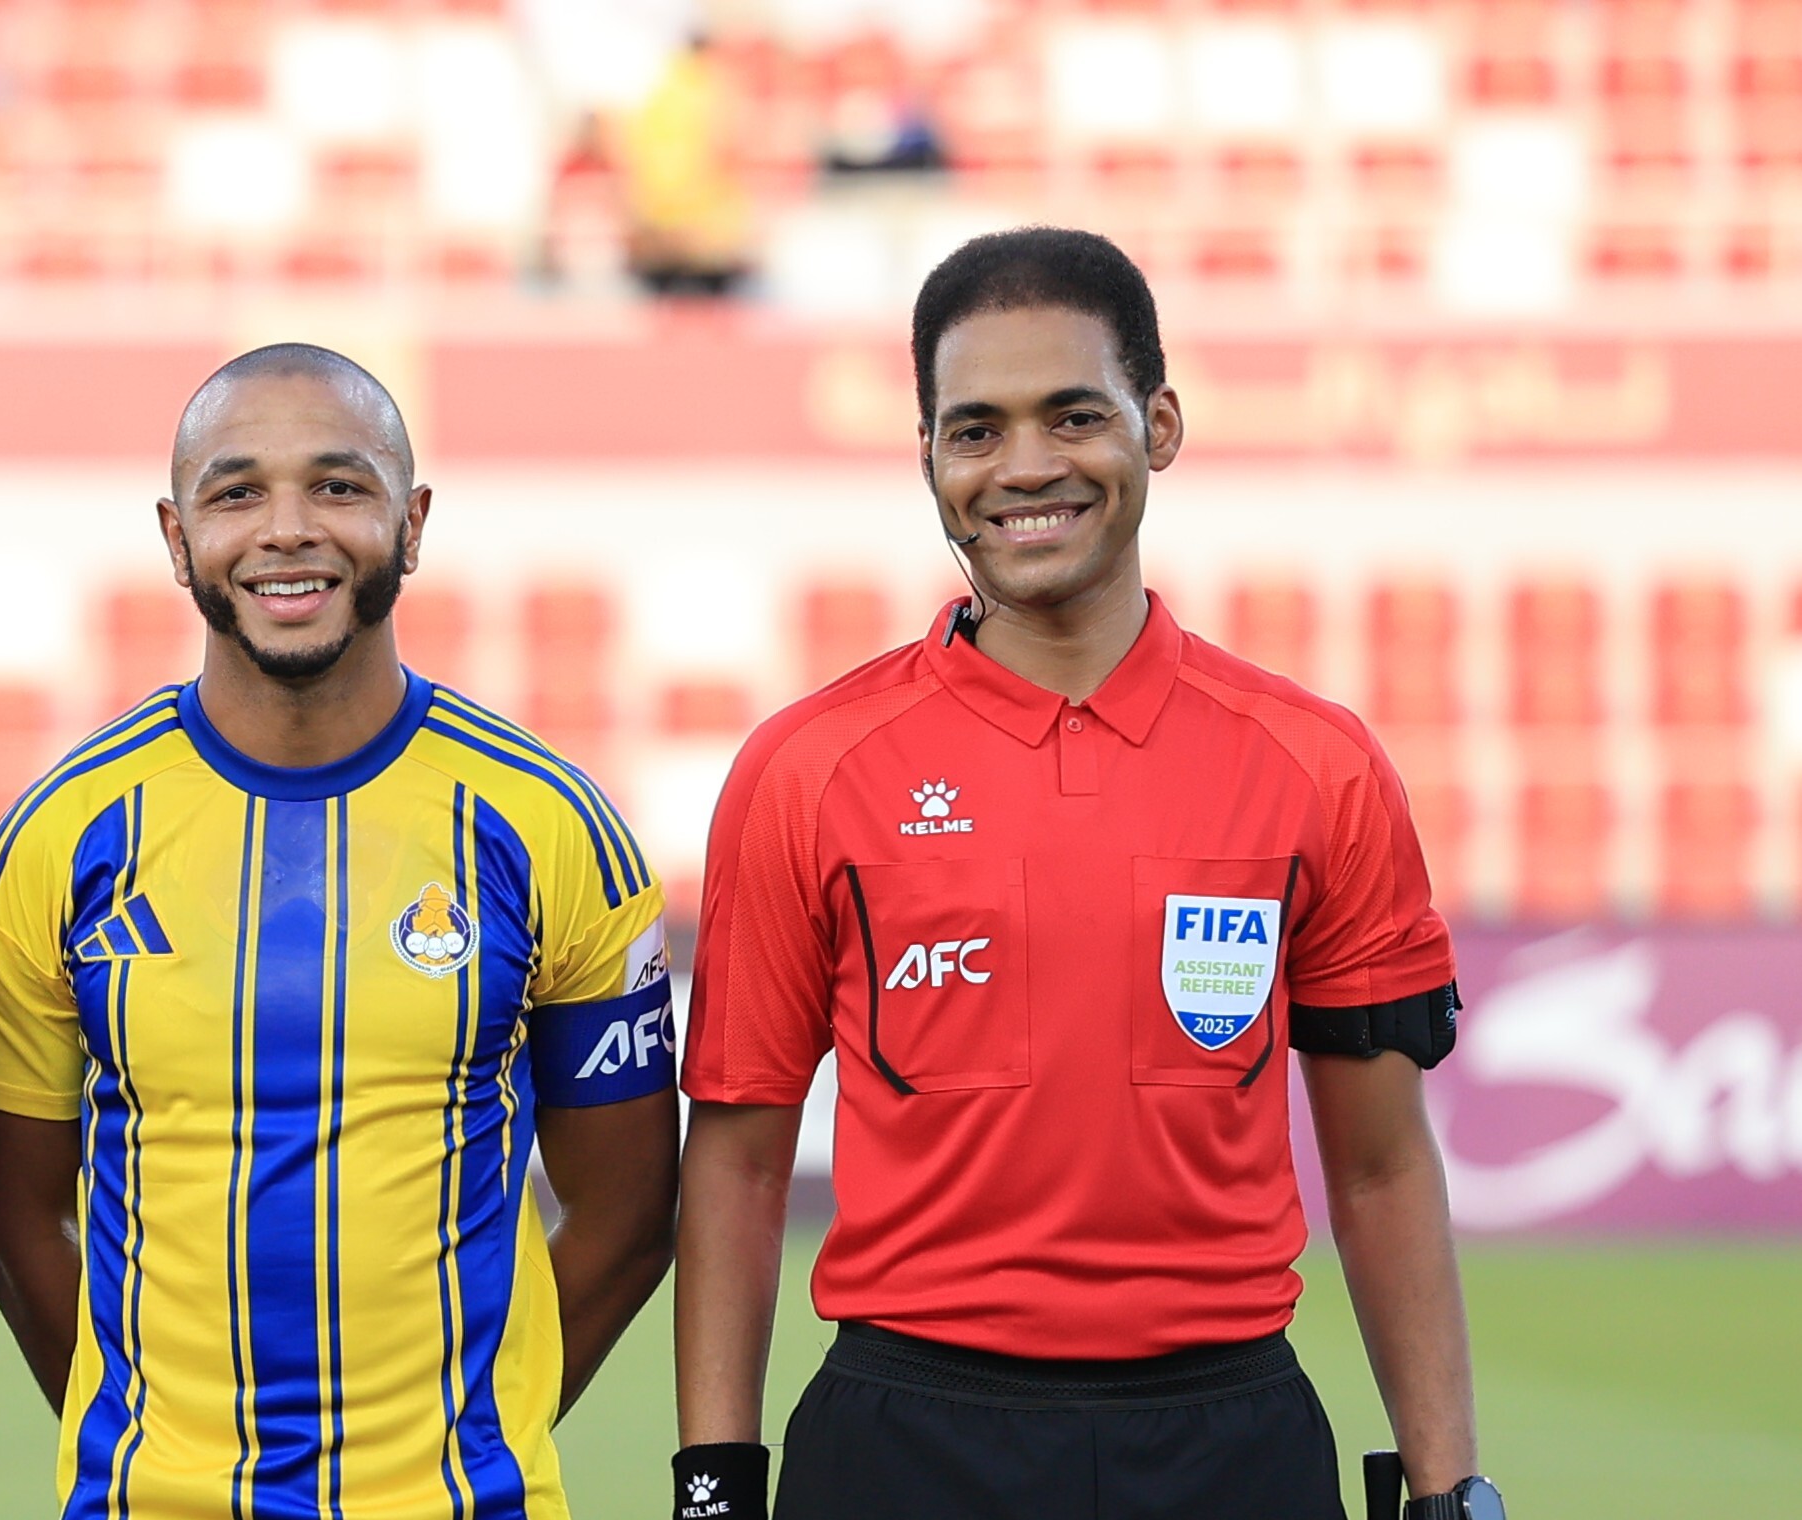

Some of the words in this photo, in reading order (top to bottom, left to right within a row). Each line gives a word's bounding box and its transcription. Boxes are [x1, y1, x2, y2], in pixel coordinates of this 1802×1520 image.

[900, 819, 973, 835] KELME
[1176, 907, 1268, 945] FIFA
[885, 937, 992, 990] AFC
[1173, 959, 1265, 978] ASSISTANT
[1178, 978, 1256, 996] REFEREE
[1192, 1017, 1235, 1035] 2025
[682, 1500, 730, 1519] KELME
